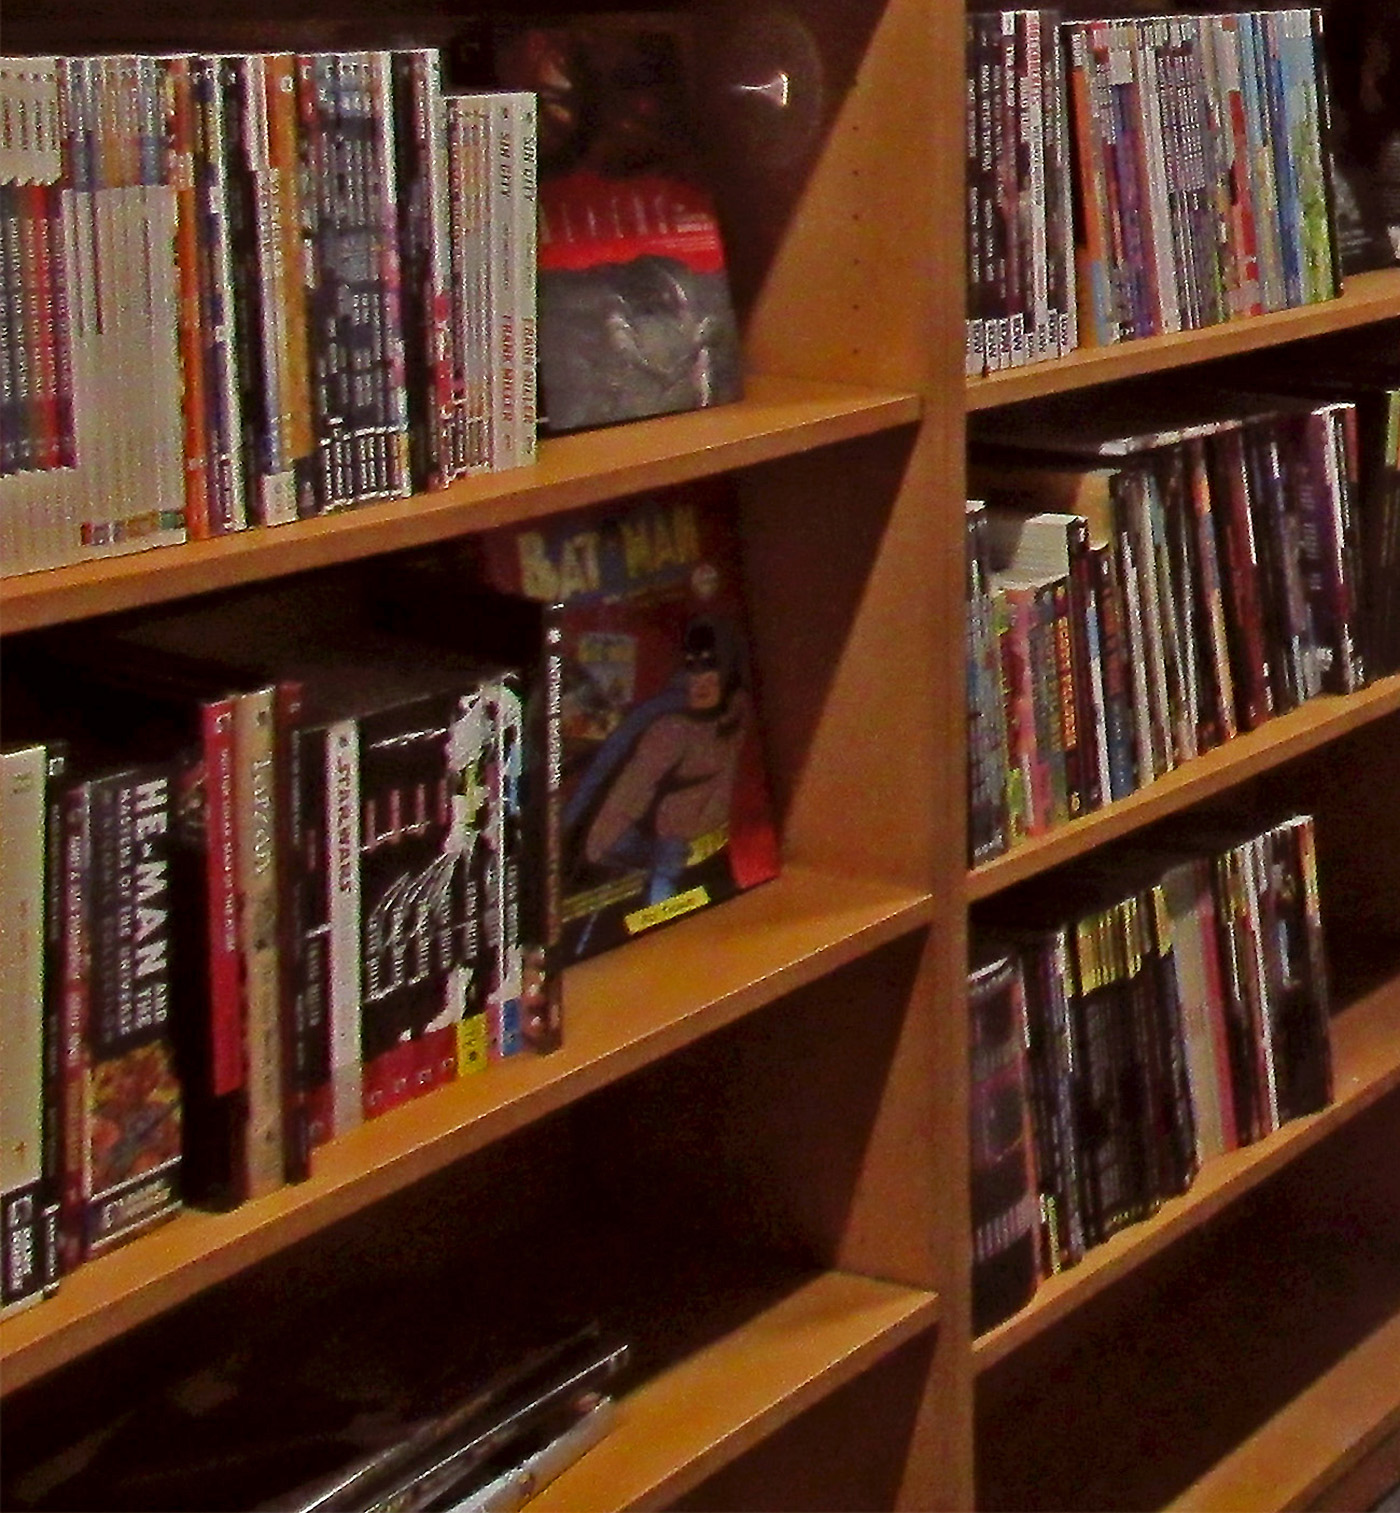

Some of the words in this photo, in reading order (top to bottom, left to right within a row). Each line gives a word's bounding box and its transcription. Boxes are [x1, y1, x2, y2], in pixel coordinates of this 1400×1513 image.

[499, 131, 513, 157] SIN
[522, 137, 535, 164] SIN
[522, 168, 536, 203] CITY
[501, 367, 513, 422] MILLER
[522, 370, 536, 425] MILLER
[517, 502, 700, 603] BATMAN
[337, 755, 352, 819] STAR
[119, 788, 132, 870] MASTERS
[339, 820, 353, 893] WARS
[120, 874, 132, 898] OF
[134, 777, 169, 981] HE-MAN
[120, 906, 132, 938] THE
[119, 946, 132, 1036] UNIVERSE
[135, 987, 152, 1029] THE
[154, 982, 168, 1025] AND
